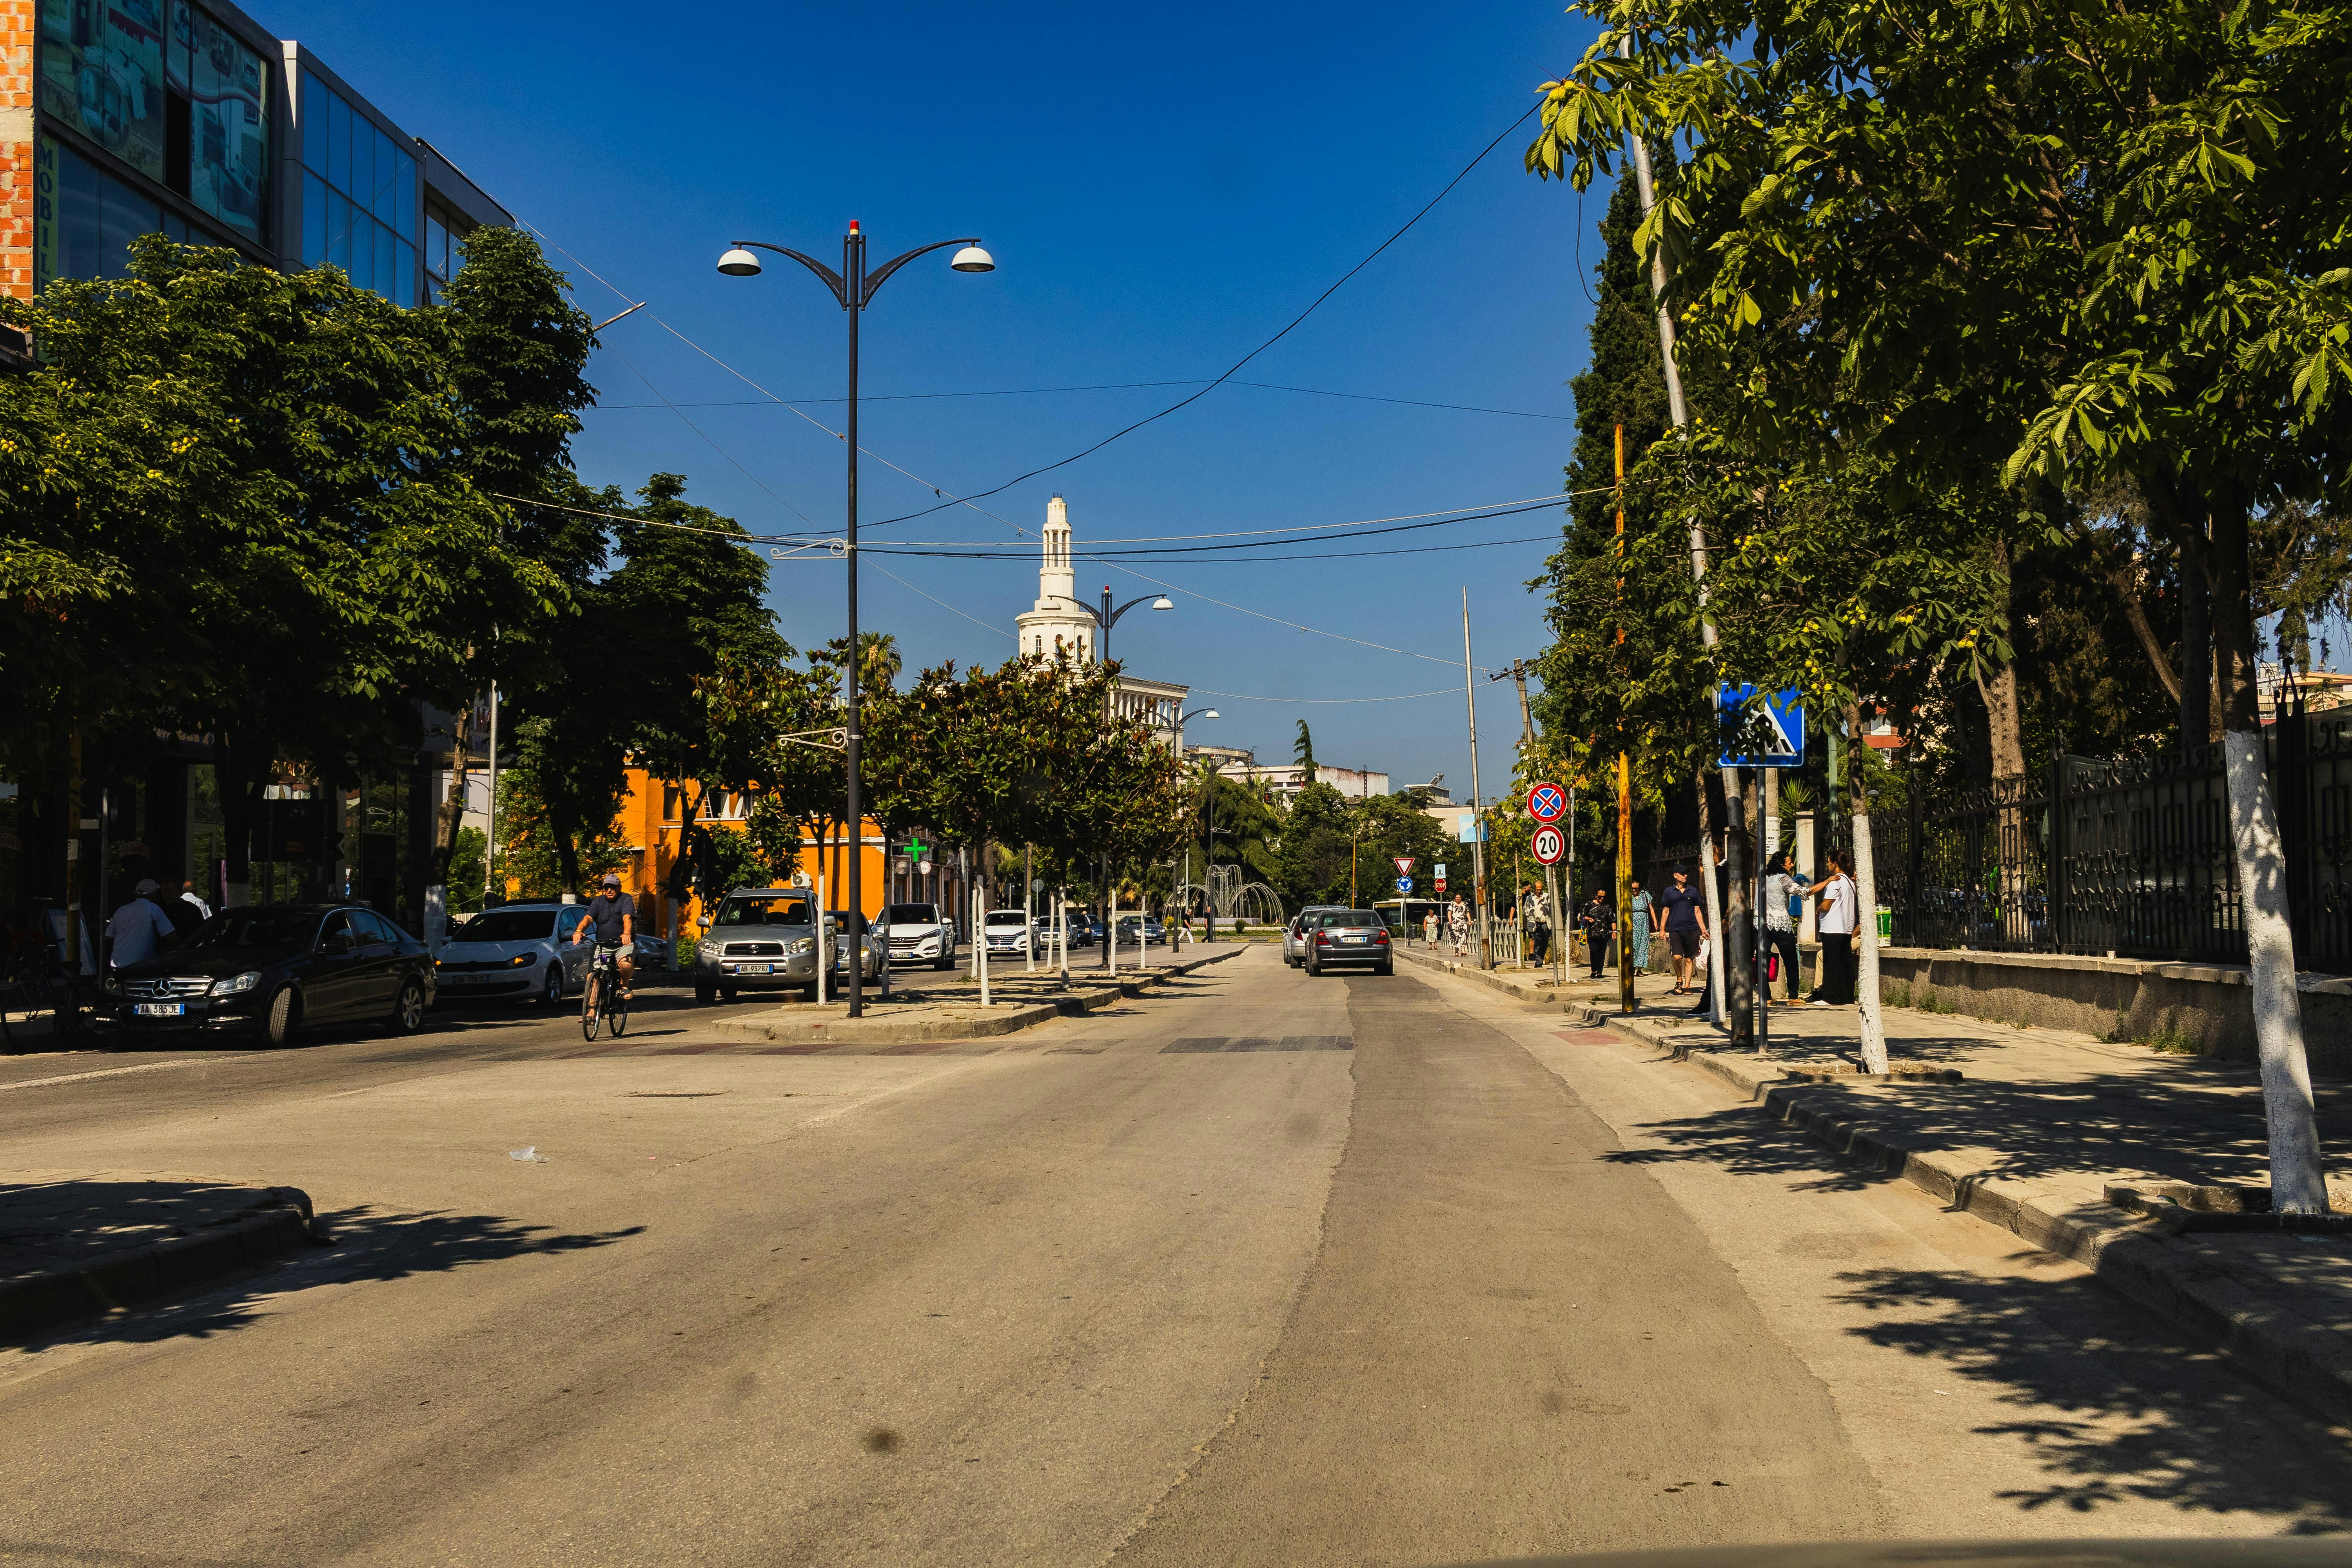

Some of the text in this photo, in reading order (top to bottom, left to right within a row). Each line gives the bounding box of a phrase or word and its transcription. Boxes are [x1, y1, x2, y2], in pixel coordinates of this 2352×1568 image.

[1539, 835, 1557, 855] 20
[140, 1005, 149, 1014] AA
[153, 1005, 167, 1014] 383
